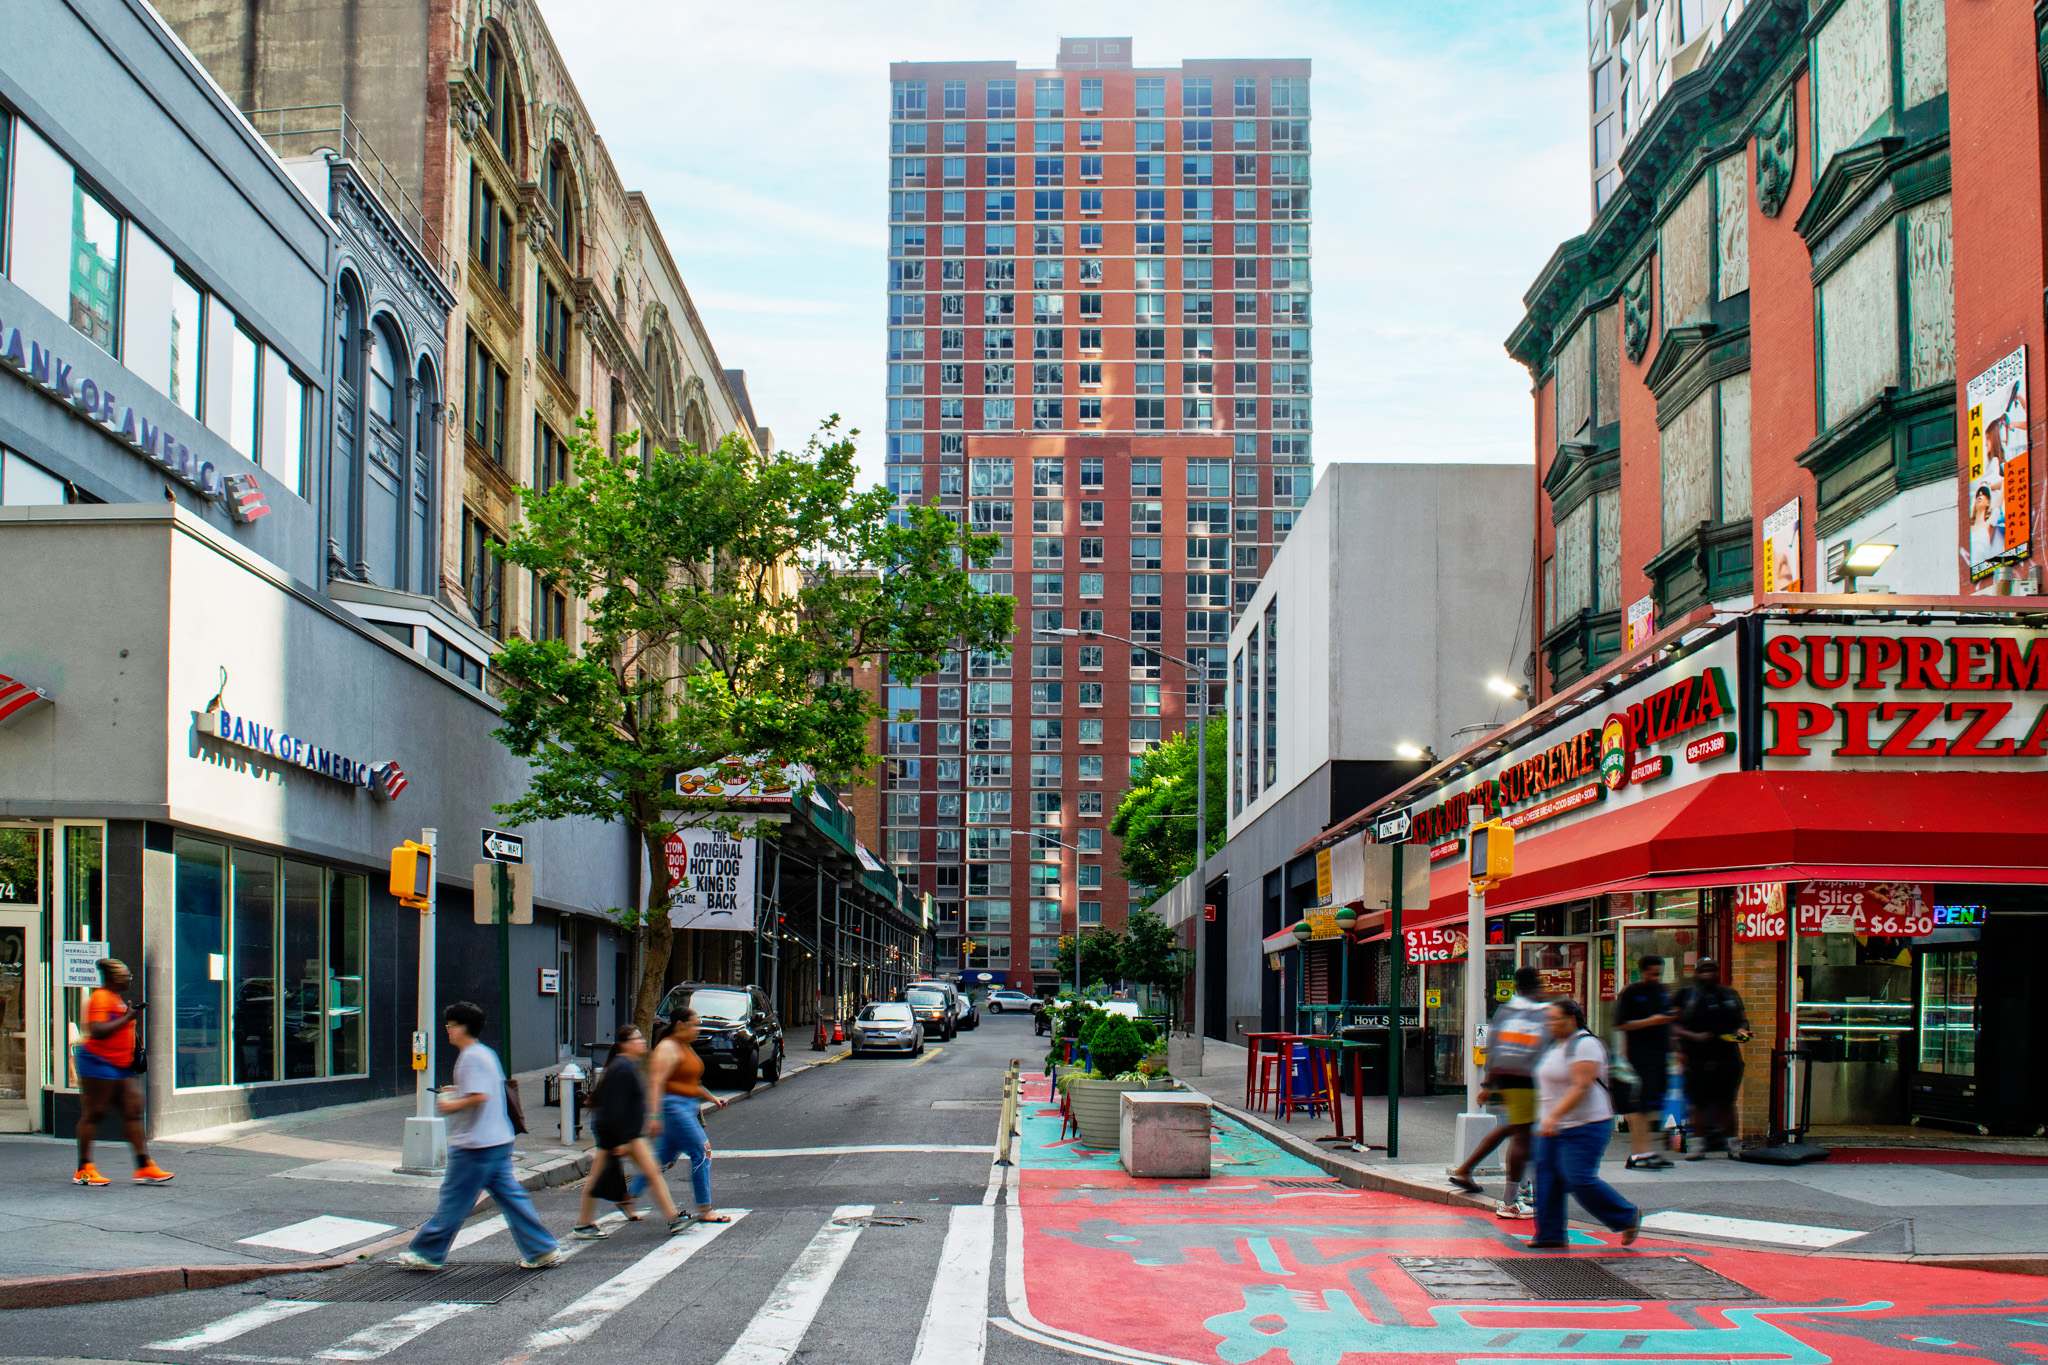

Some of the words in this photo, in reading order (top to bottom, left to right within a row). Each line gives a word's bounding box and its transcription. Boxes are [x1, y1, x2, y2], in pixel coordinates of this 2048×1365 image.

[0, 318, 72, 398] ANK
[80, 378, 116, 423] OF
[1969, 367, 1997, 392] FULTON
[1998, 349, 2023, 369] SALON
[1970, 405, 1982, 479] HAIR
[2007, 462, 2016, 503] LASER
[2017, 467, 2028, 528] REMOVAL
[2007, 511, 2017, 546] HAIR
[1764, 634, 2048, 690] SUPREM
[1499, 728, 1597, 807] SUPREME
[1627, 667, 1724, 753] PIZZA
[220, 710, 275, 755] BANK
[279, 733, 302, 762] OF
[306, 744, 376, 791] AMERICA
[1687, 736, 1725, 760] 929-773-3690
[1638, 763, 1653, 778] FULTON
[1652, 759, 1661, 772] AVE
[1525, 808, 1540, 822] CHEESE
[1554, 798, 1567, 811] COCO
[1567, 792, 1581, 806] BREAD
[1584, 786, 1597, 800] SODA
[1382, 822, 1393, 836] ONE
[1396, 818, 1408, 832] WAY
[712, 831, 727, 842] THE
[491, 840, 503, 852] ONE
[507, 843, 520, 855] WAY
[665, 842, 683, 853] LTON
[694, 842, 743, 859] ORIGINAL
[669, 855, 684, 865] DOG
[690, 858, 713, 875] HOT
[716, 860, 739, 876] DOG
[696, 876, 723, 892] KING
[727, 877, 736, 892] IS
[707, 893, 737, 910] BACK
[1736, 884, 1770, 907] $1.50
[1819, 890, 1864, 904] Slice
[1933, 907, 1975, 923] PEN
[1746, 912, 1785, 938] Slice
[1870, 915, 1933, 935] $6.50
[1407, 929, 1456, 947] $1.50
[1490, 930, 1503, 945] OPE
[1408, 948, 1448, 962] Slice
[1354, 1015, 1379, 1026] Hoyt
[1382, 1016, 1390, 1025] S
[1399, 1016, 1419, 1025] Stat
